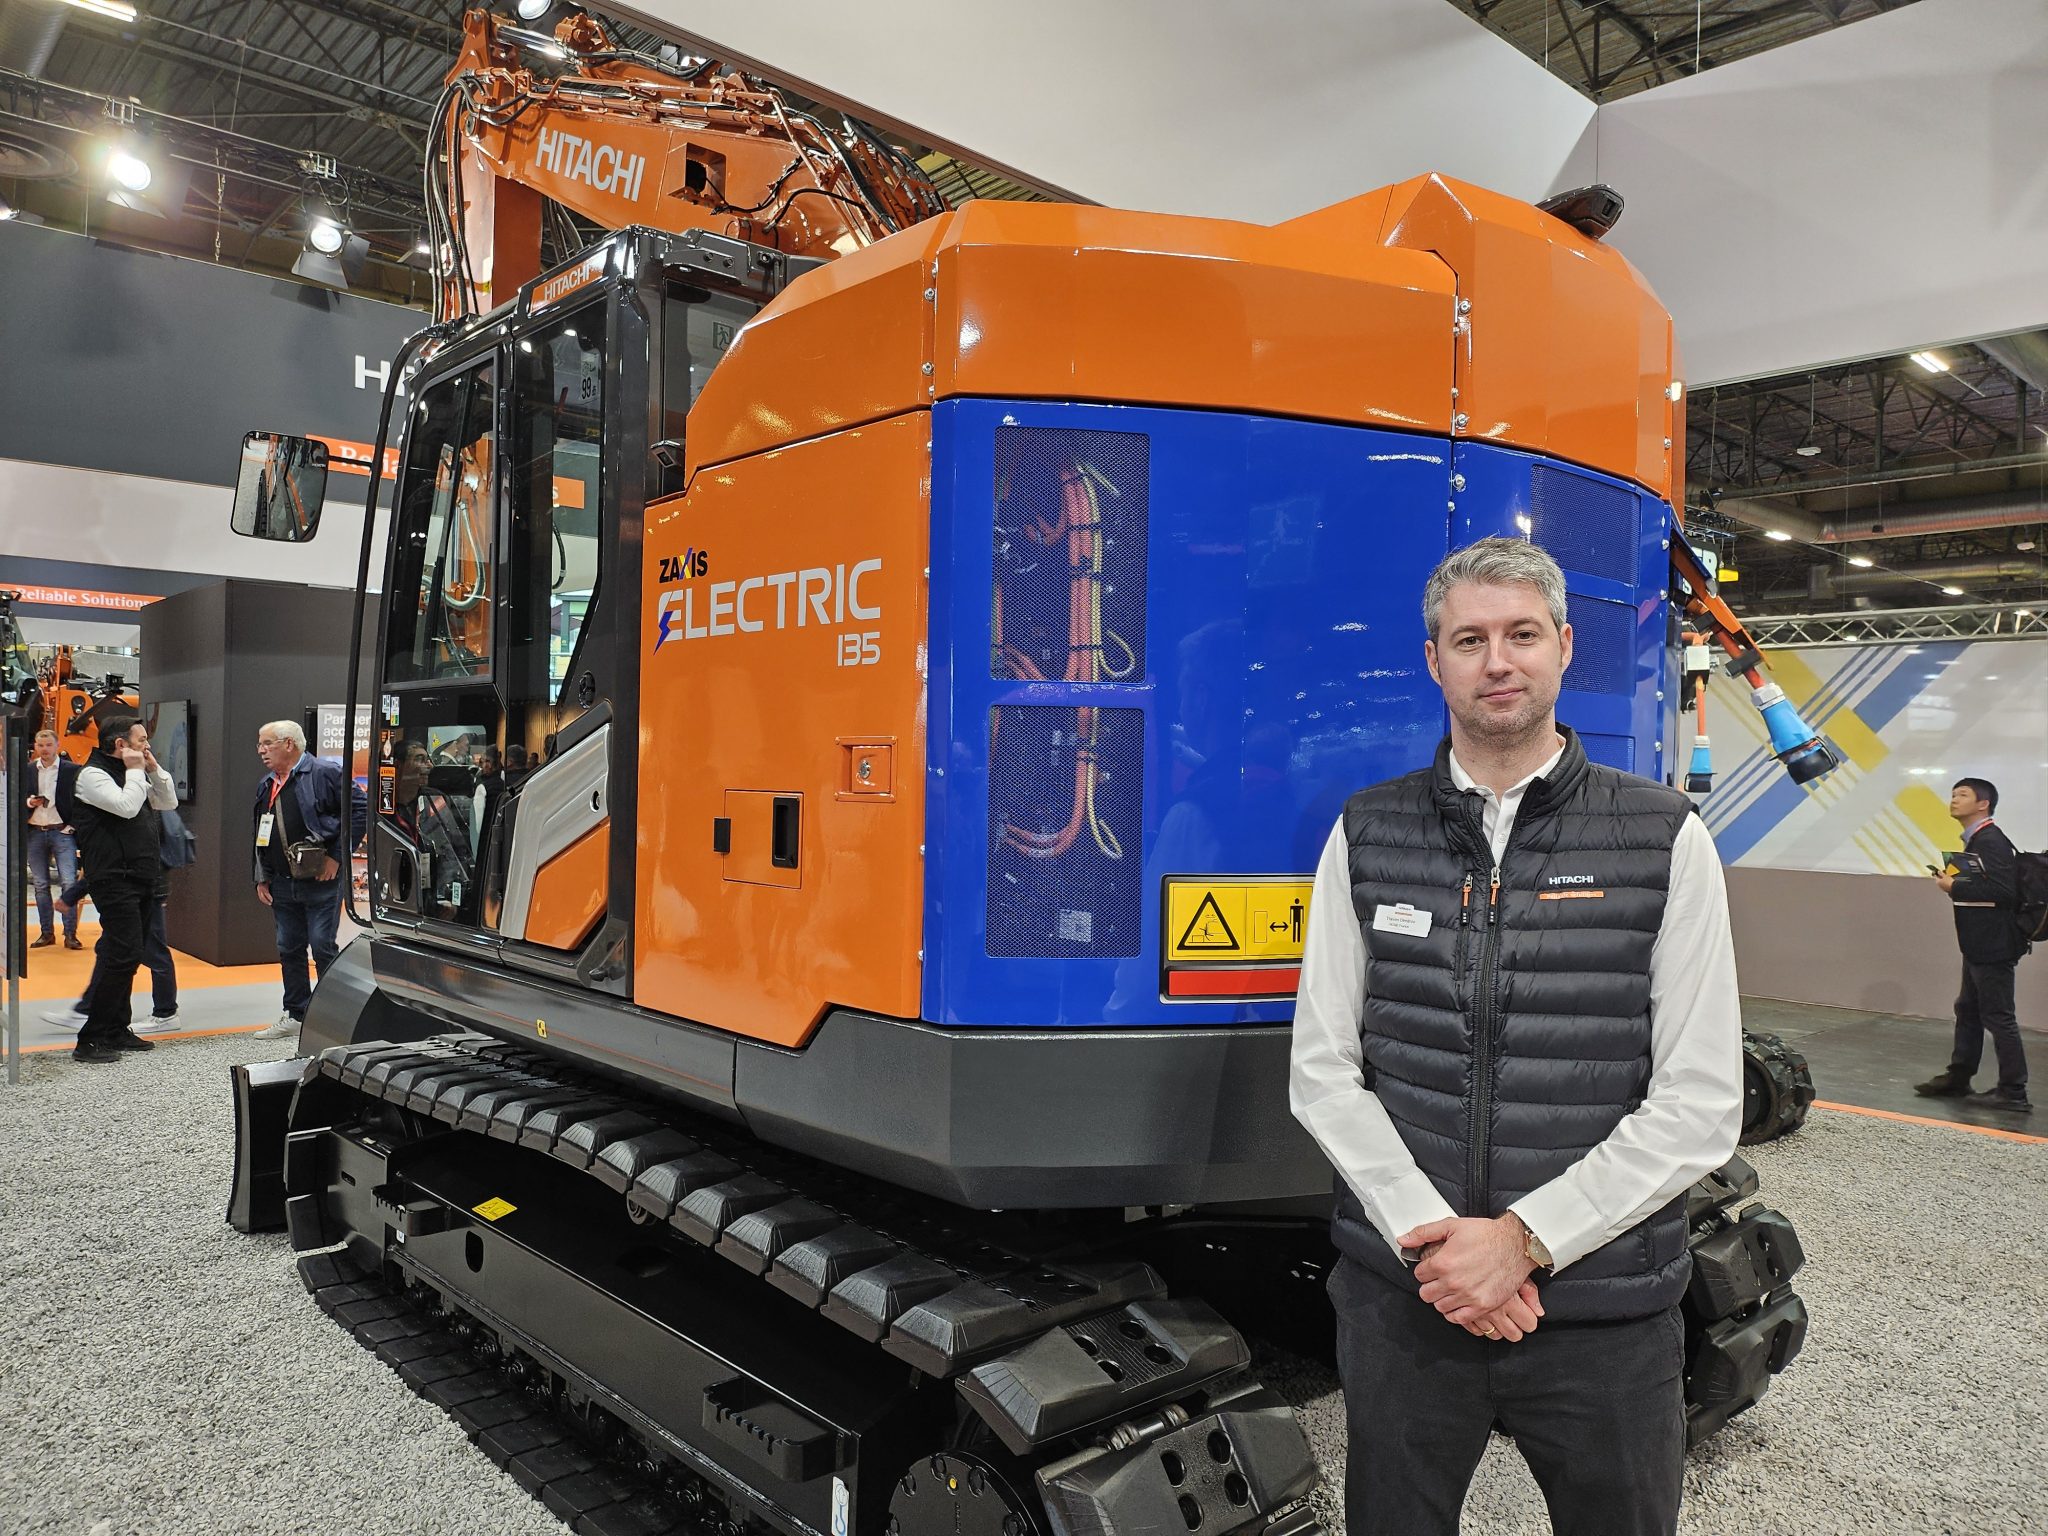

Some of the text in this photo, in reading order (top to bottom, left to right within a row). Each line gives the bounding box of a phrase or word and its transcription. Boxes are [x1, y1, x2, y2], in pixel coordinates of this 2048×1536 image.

[535, 126, 646, 203] HITACHI
[544, 263, 591, 303] HITACHI
[658, 547, 709, 584] ZAXIS
[655, 557, 882, 647] ELECTRIC
[837, 631, 881, 667] 135
[322, 737, 369, 751] chage
[1548, 875, 1594, 885] HITACHI
